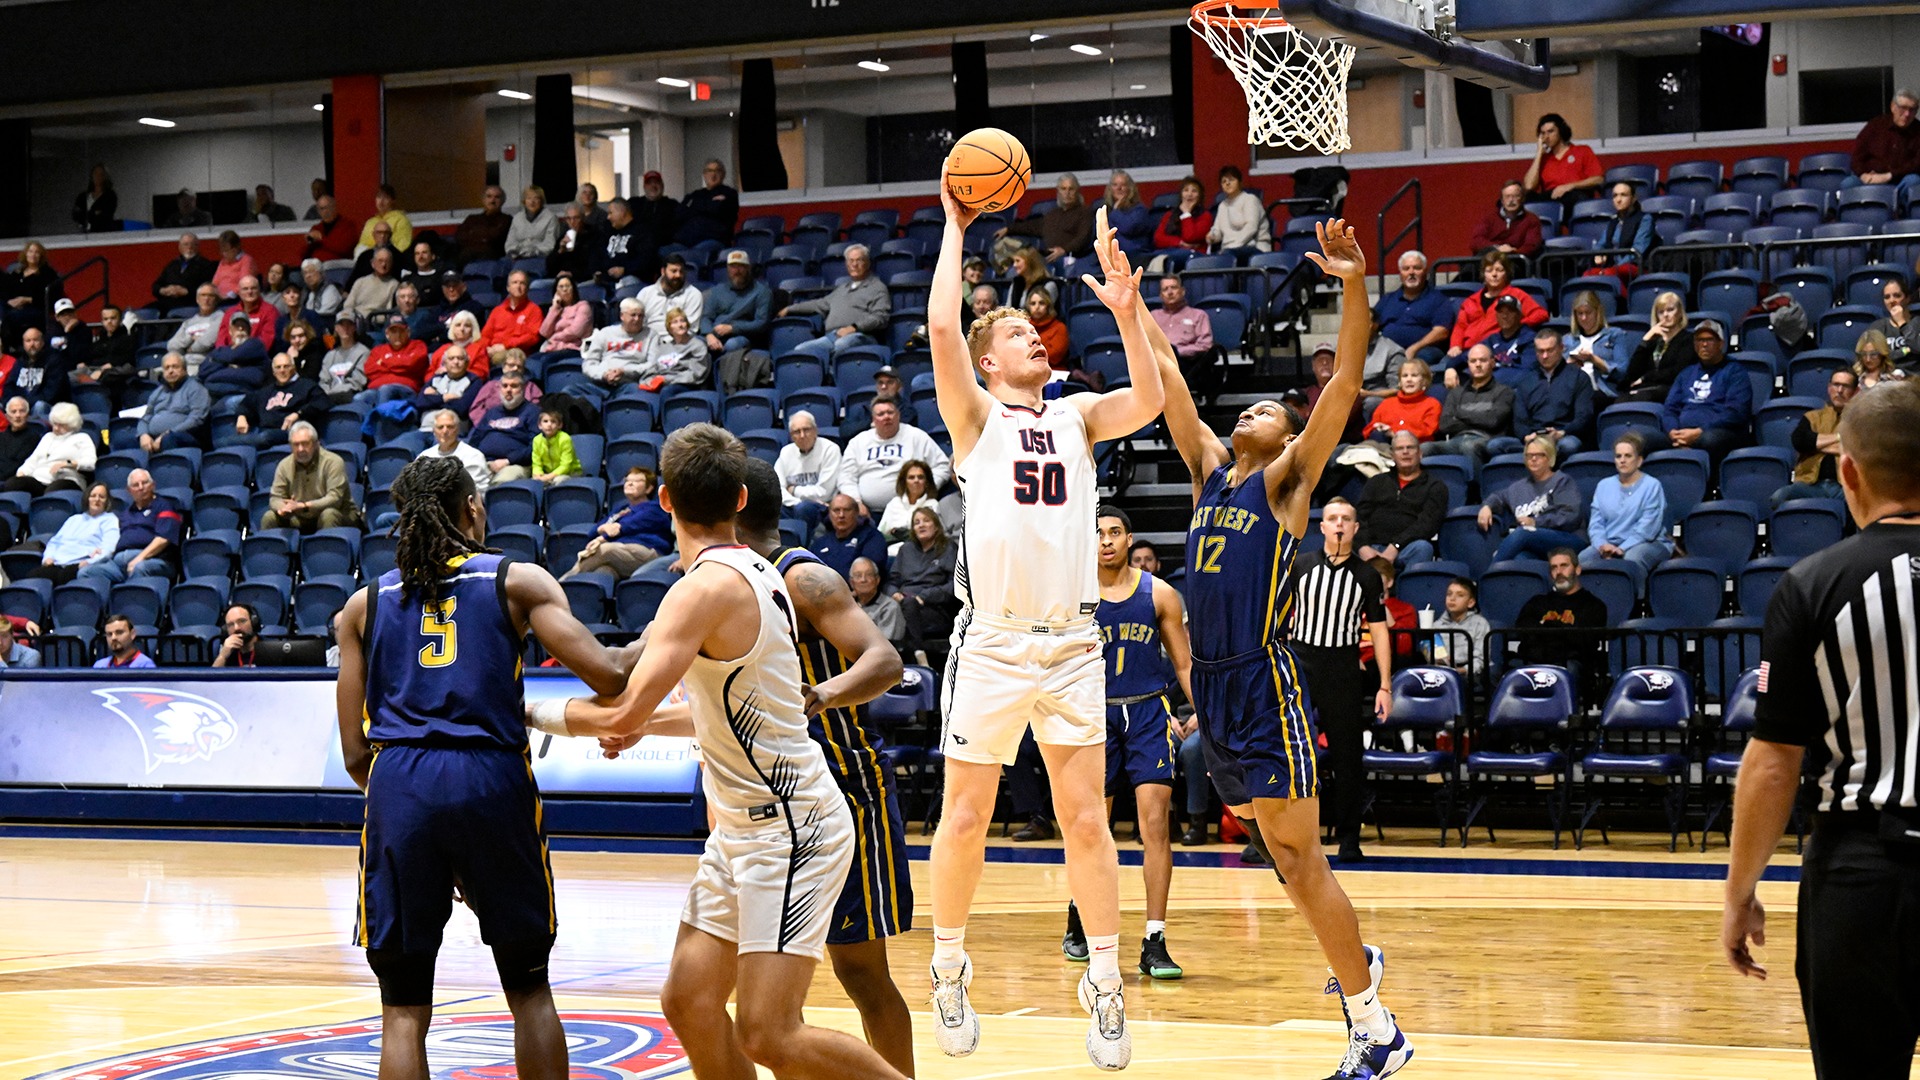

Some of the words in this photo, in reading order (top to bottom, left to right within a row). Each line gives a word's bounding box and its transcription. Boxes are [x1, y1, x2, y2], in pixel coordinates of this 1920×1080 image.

[867, 443, 904, 461] USI
[1017, 427, 1057, 456] USI
[1012, 460, 1068, 506] 50
[1190, 506, 1213, 536] AST
[1213, 506, 1260, 535] WEST
[1194, 534, 1227, 574] 12
[418, 595, 458, 669] 3
[1118, 622, 1155, 645] WEST
[1115, 646, 1126, 677] 1
[586, 749, 688, 761] CVROLET
